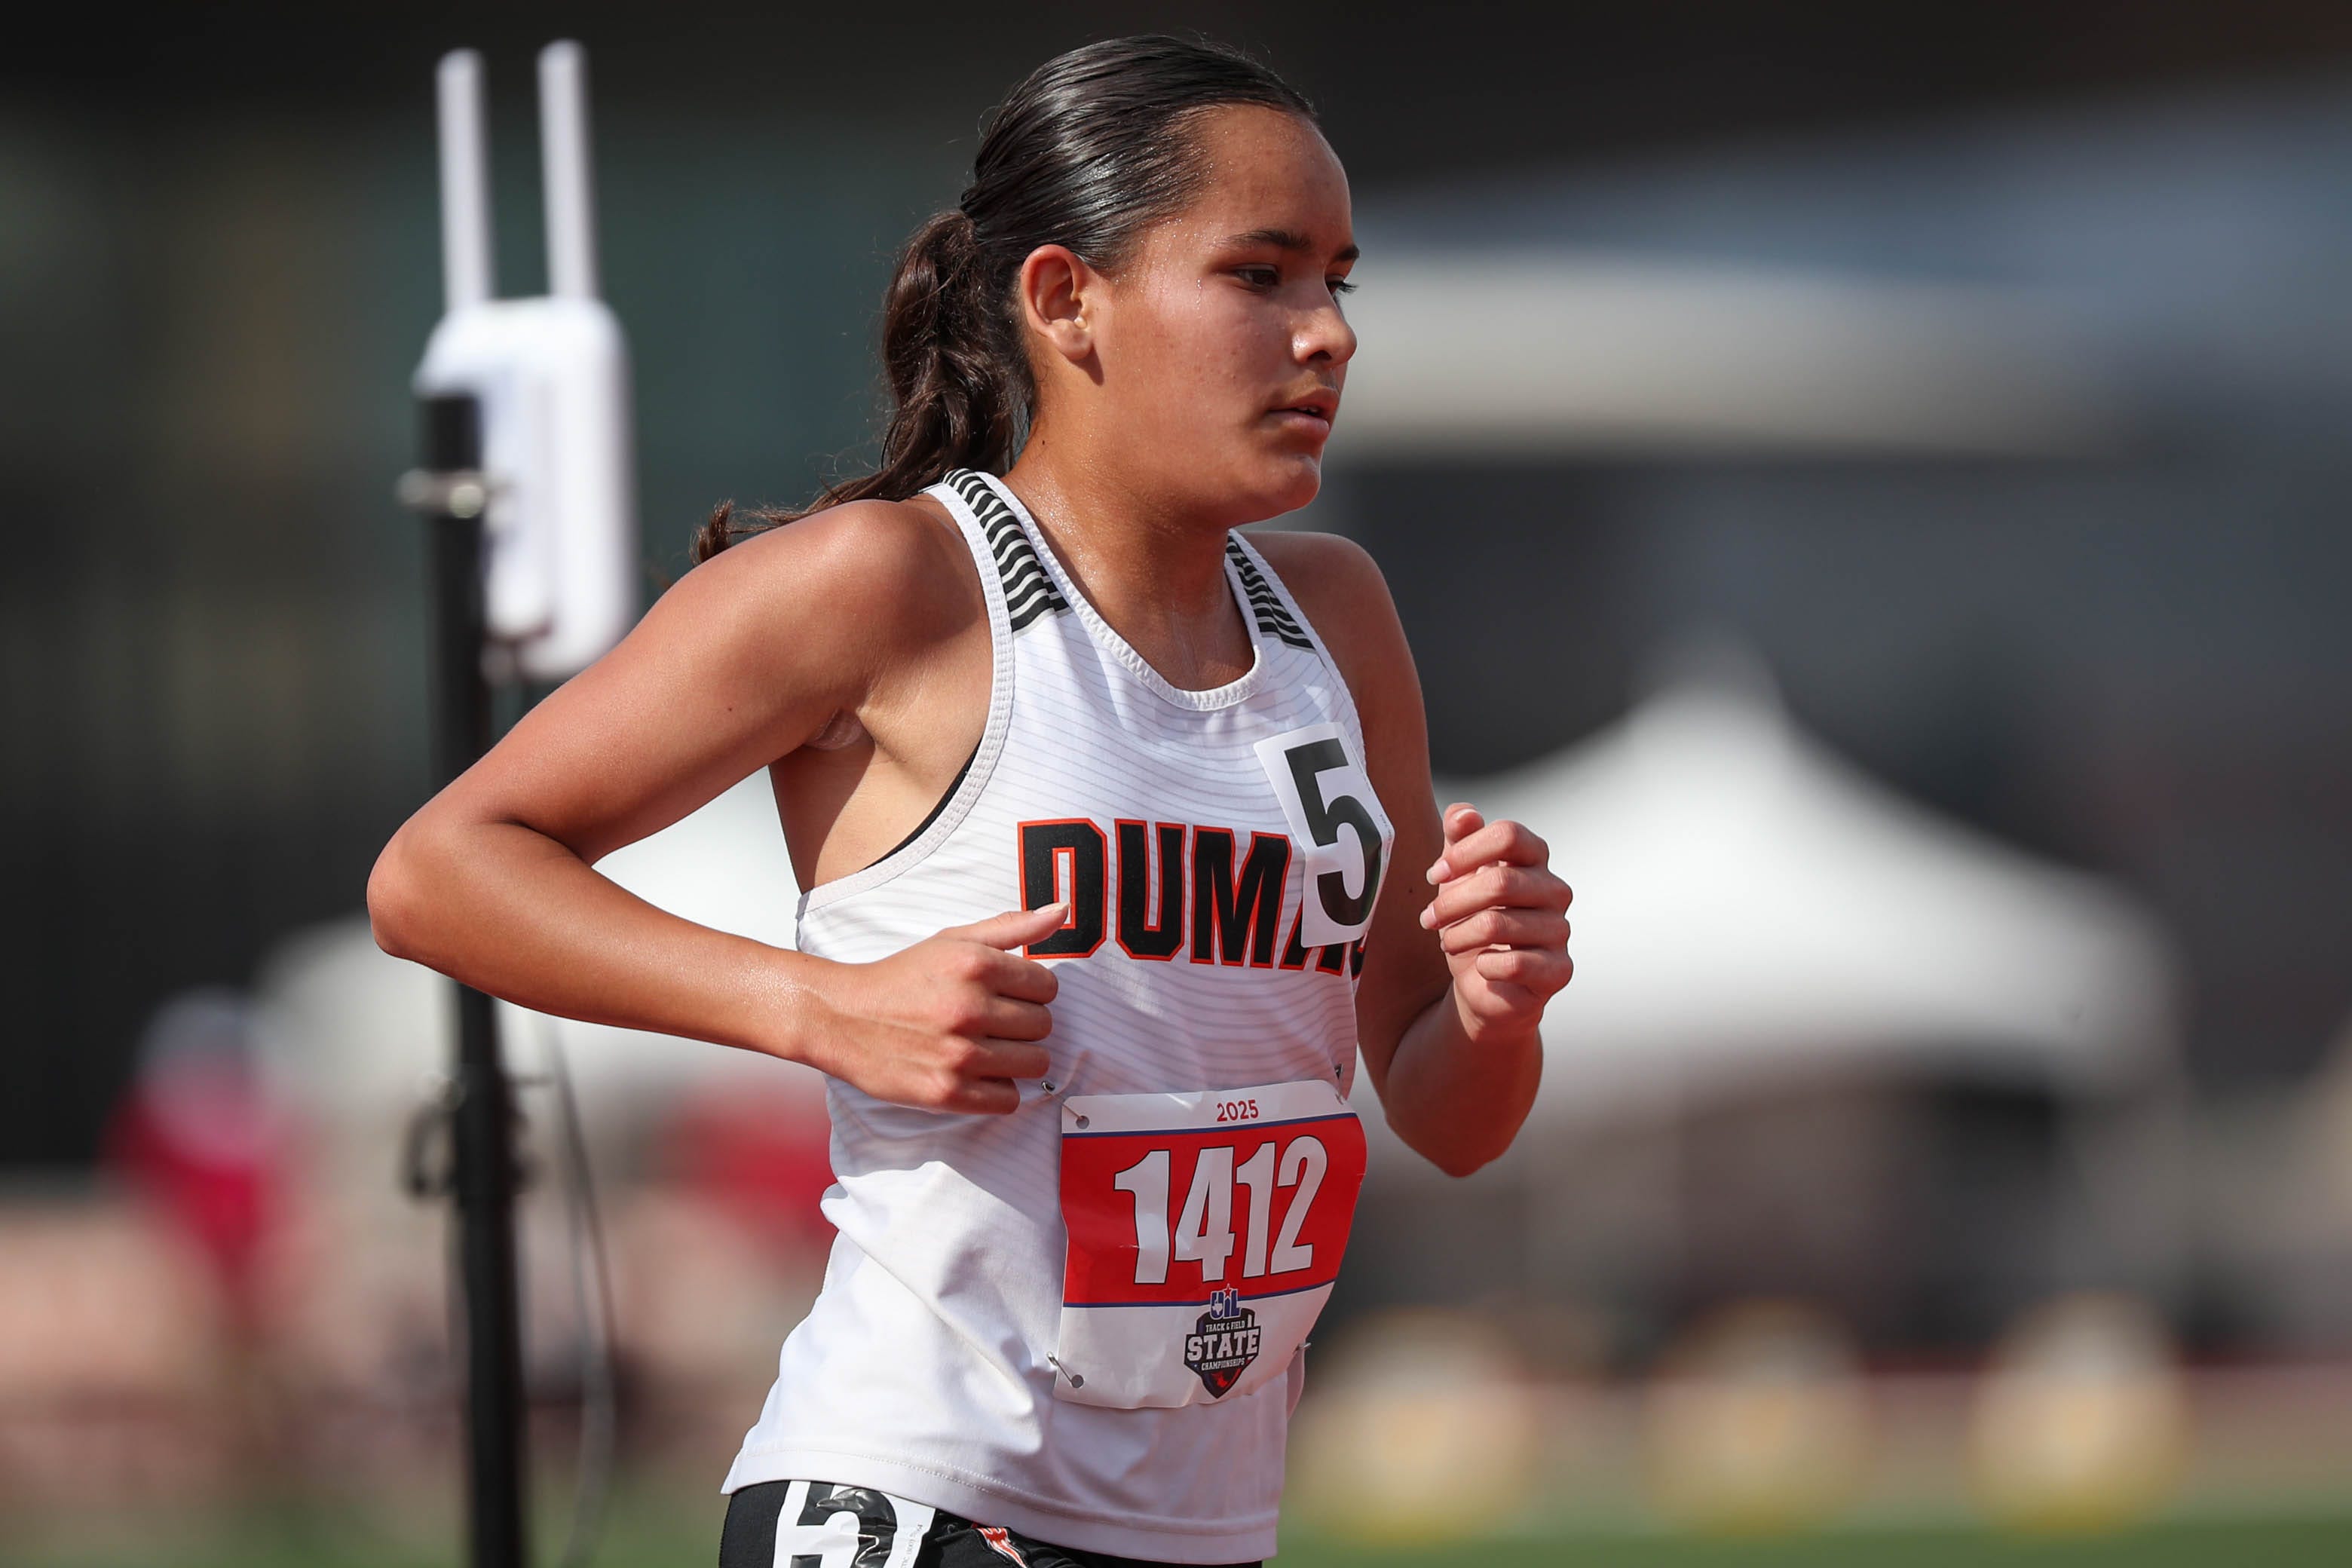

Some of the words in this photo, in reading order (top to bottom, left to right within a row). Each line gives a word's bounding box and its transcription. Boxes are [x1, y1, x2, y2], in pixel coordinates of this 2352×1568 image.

[1284, 737, 1383, 926] 5
[1017, 818, 1366, 982] DUM
[1216, 1099, 1260, 1122] 2025
[1113, 1135, 1328, 1284] 1412
[1206, 1321, 1225, 1333] TRACK
[1230, 1319, 1245, 1331] FIELD
[1187, 1328, 1260, 1361] STATE
[1201, 1357, 1245, 1371] CHAMPIONSHIPS
